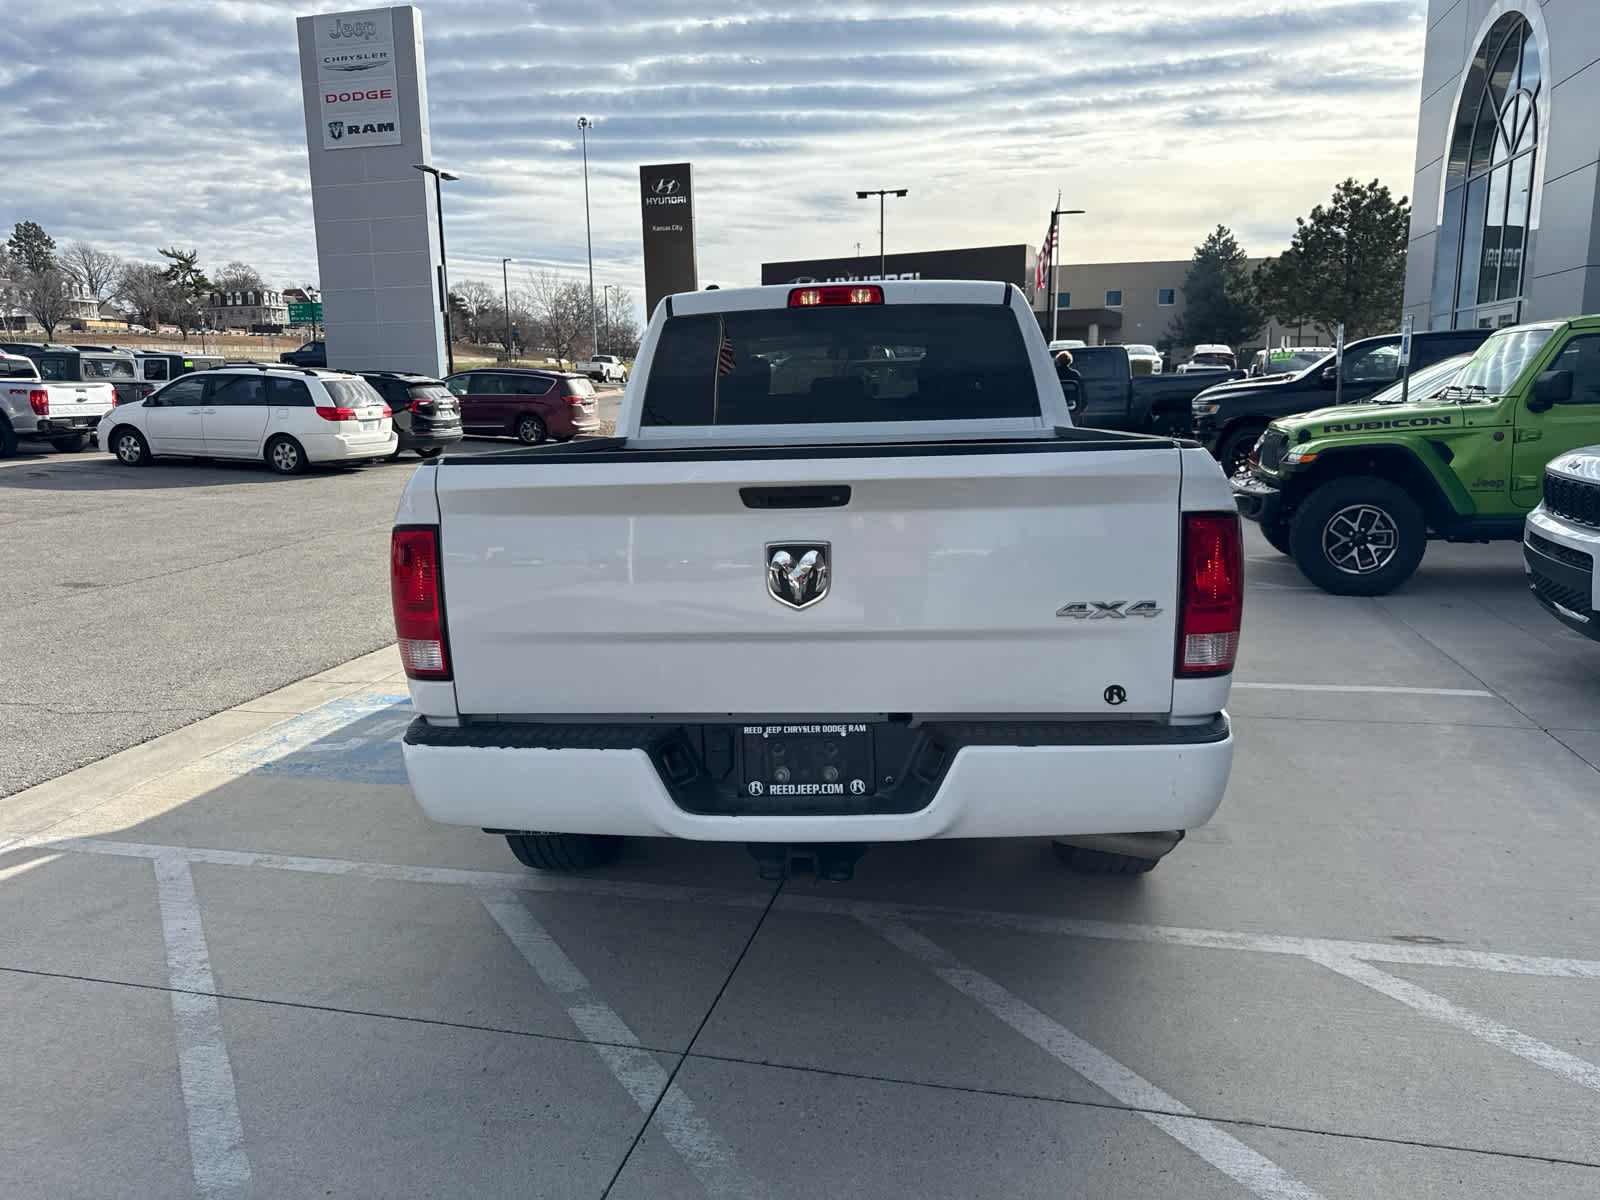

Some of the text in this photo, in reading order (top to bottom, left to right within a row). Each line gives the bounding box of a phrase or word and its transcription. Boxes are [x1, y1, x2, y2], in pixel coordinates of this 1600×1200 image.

[329, 19, 377, 40] Jeep
[323, 52, 388, 63] CHRYSLER
[325, 89, 392, 103] DODGE
[347, 122, 395, 135] RAM
[646, 196, 687, 205] HYUNDAI
[1323, 416, 1451, 433] RUBICON
[743, 724, 867, 734] REED JEEP CHRYSLER DODGE RAM
[769, 783, 844, 795] REEDJEEP.COM
